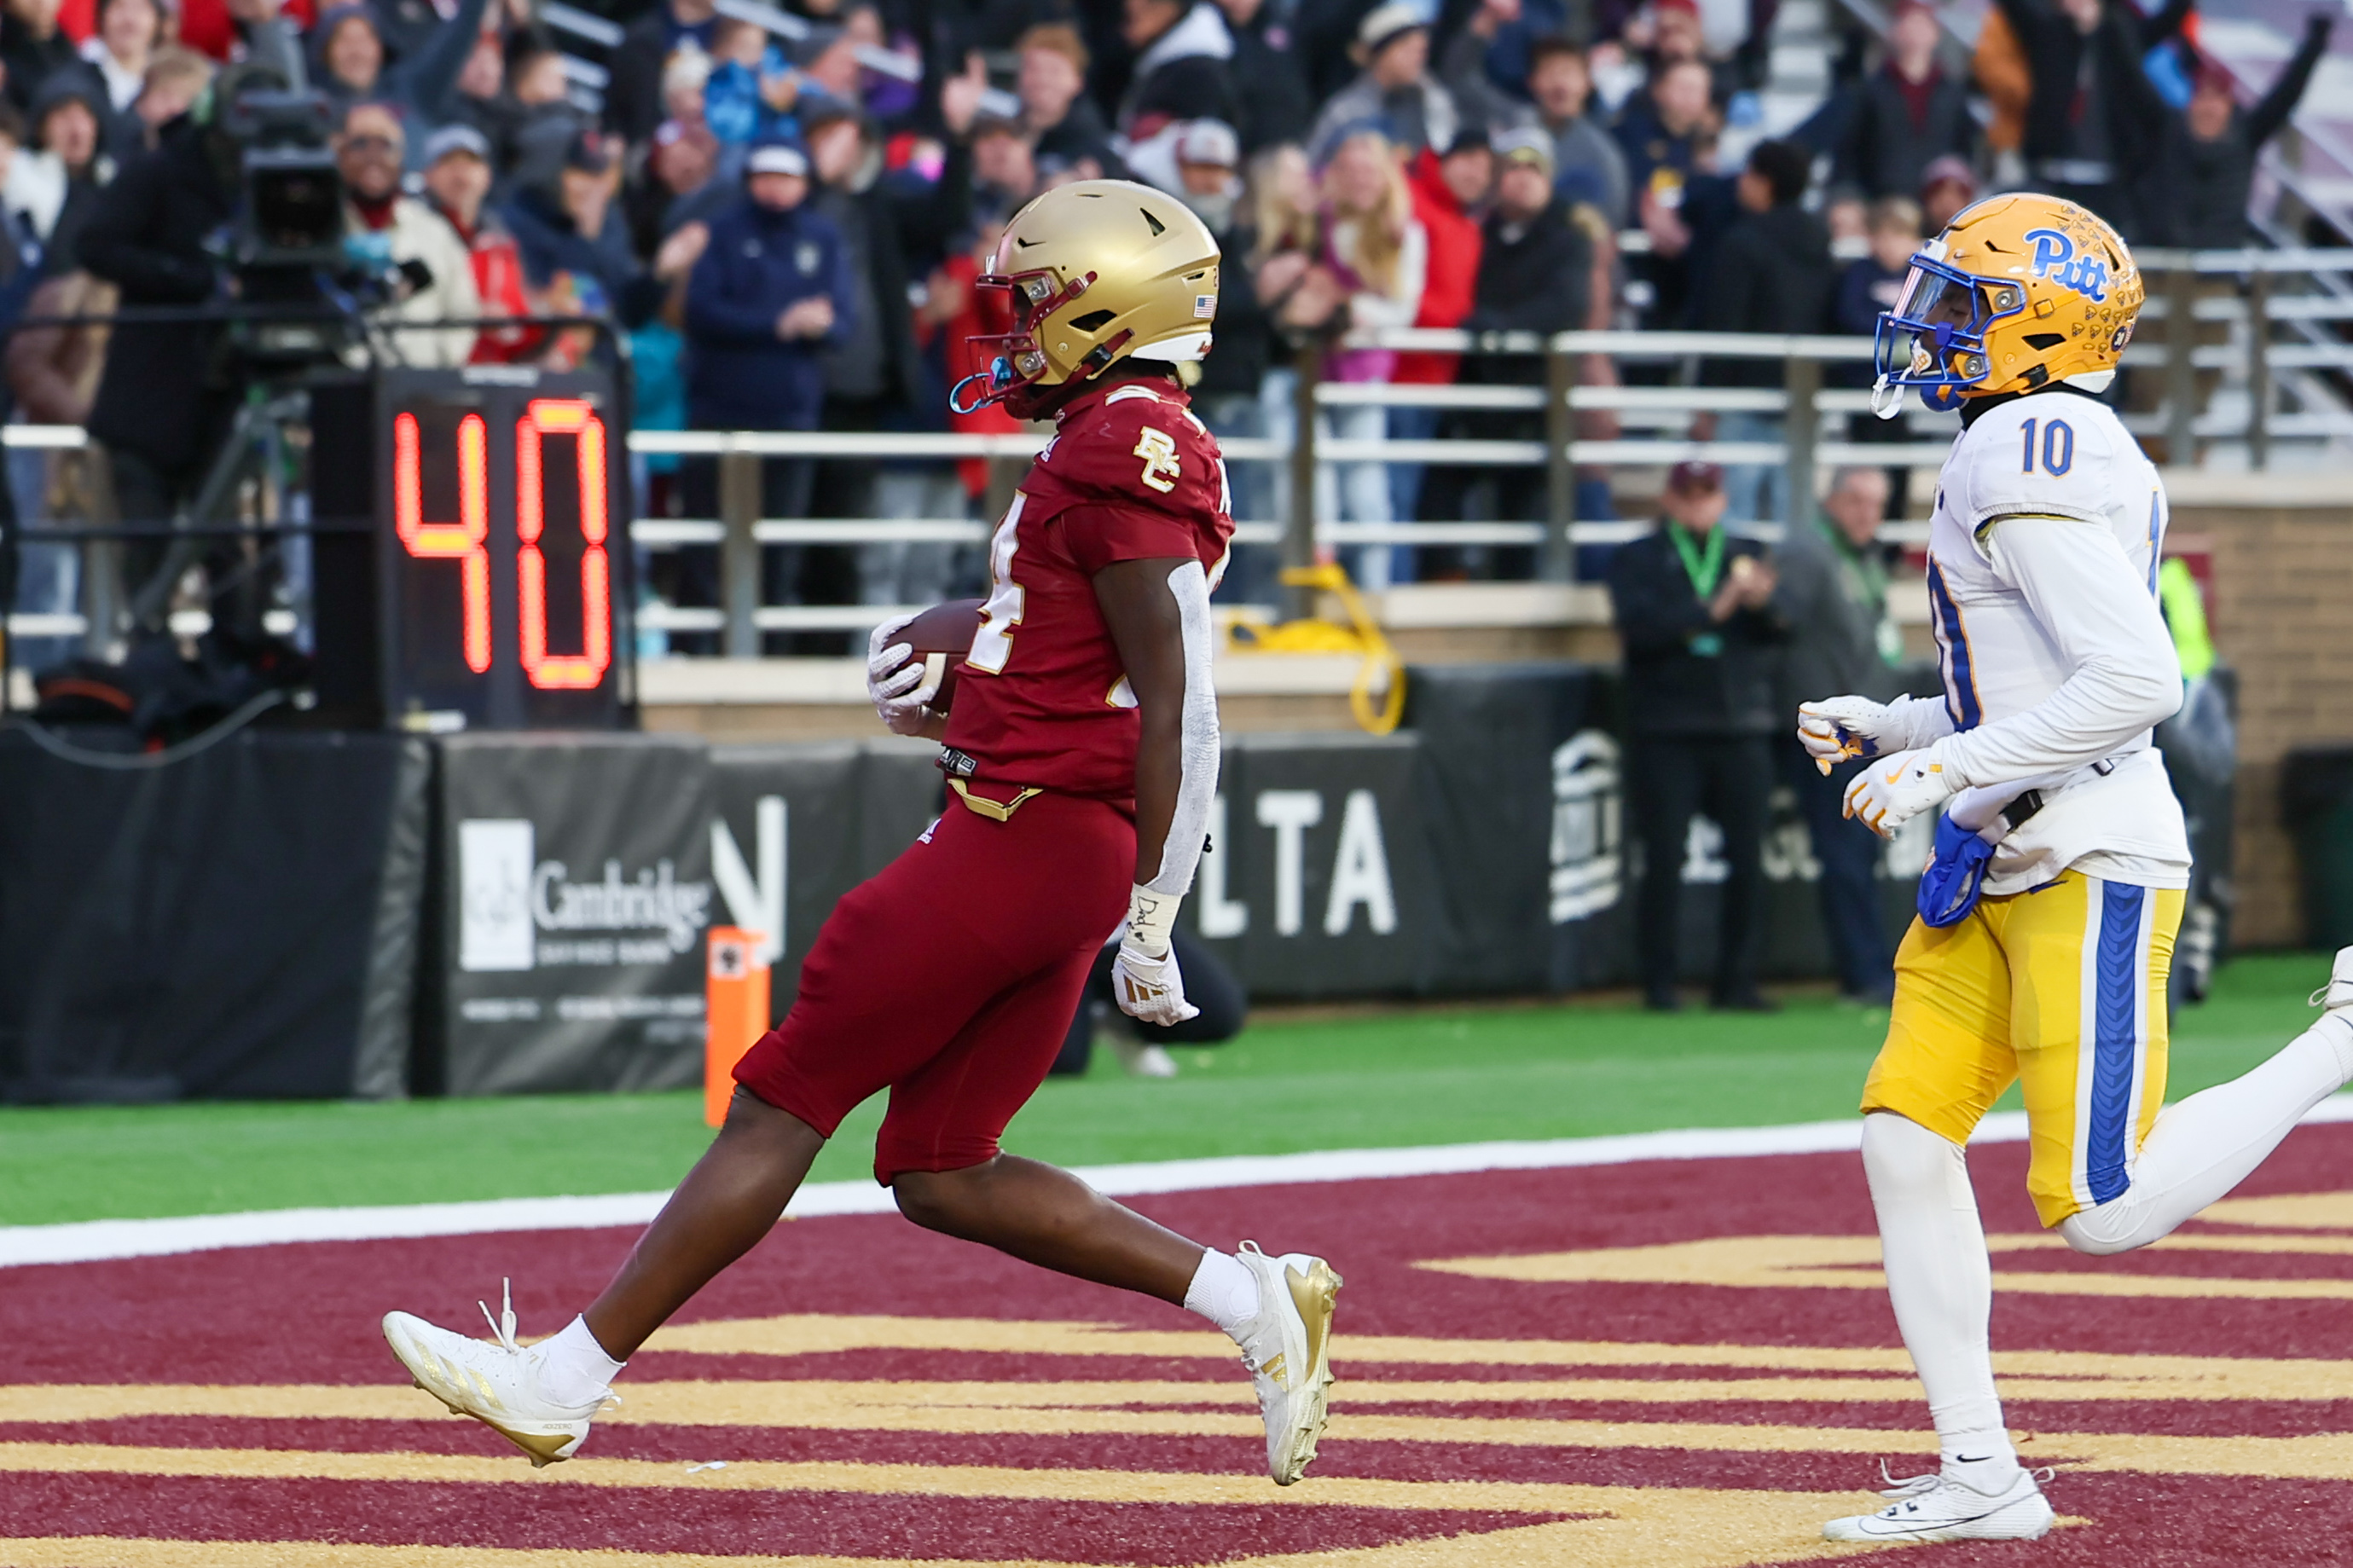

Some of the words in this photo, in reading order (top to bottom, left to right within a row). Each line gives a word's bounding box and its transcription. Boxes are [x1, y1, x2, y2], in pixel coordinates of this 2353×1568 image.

[2024, 229, 2109, 303] Pitt
[2020, 417, 2077, 479] 10
[395, 398, 611, 689] 40
[1199, 789, 1399, 938] LTA
